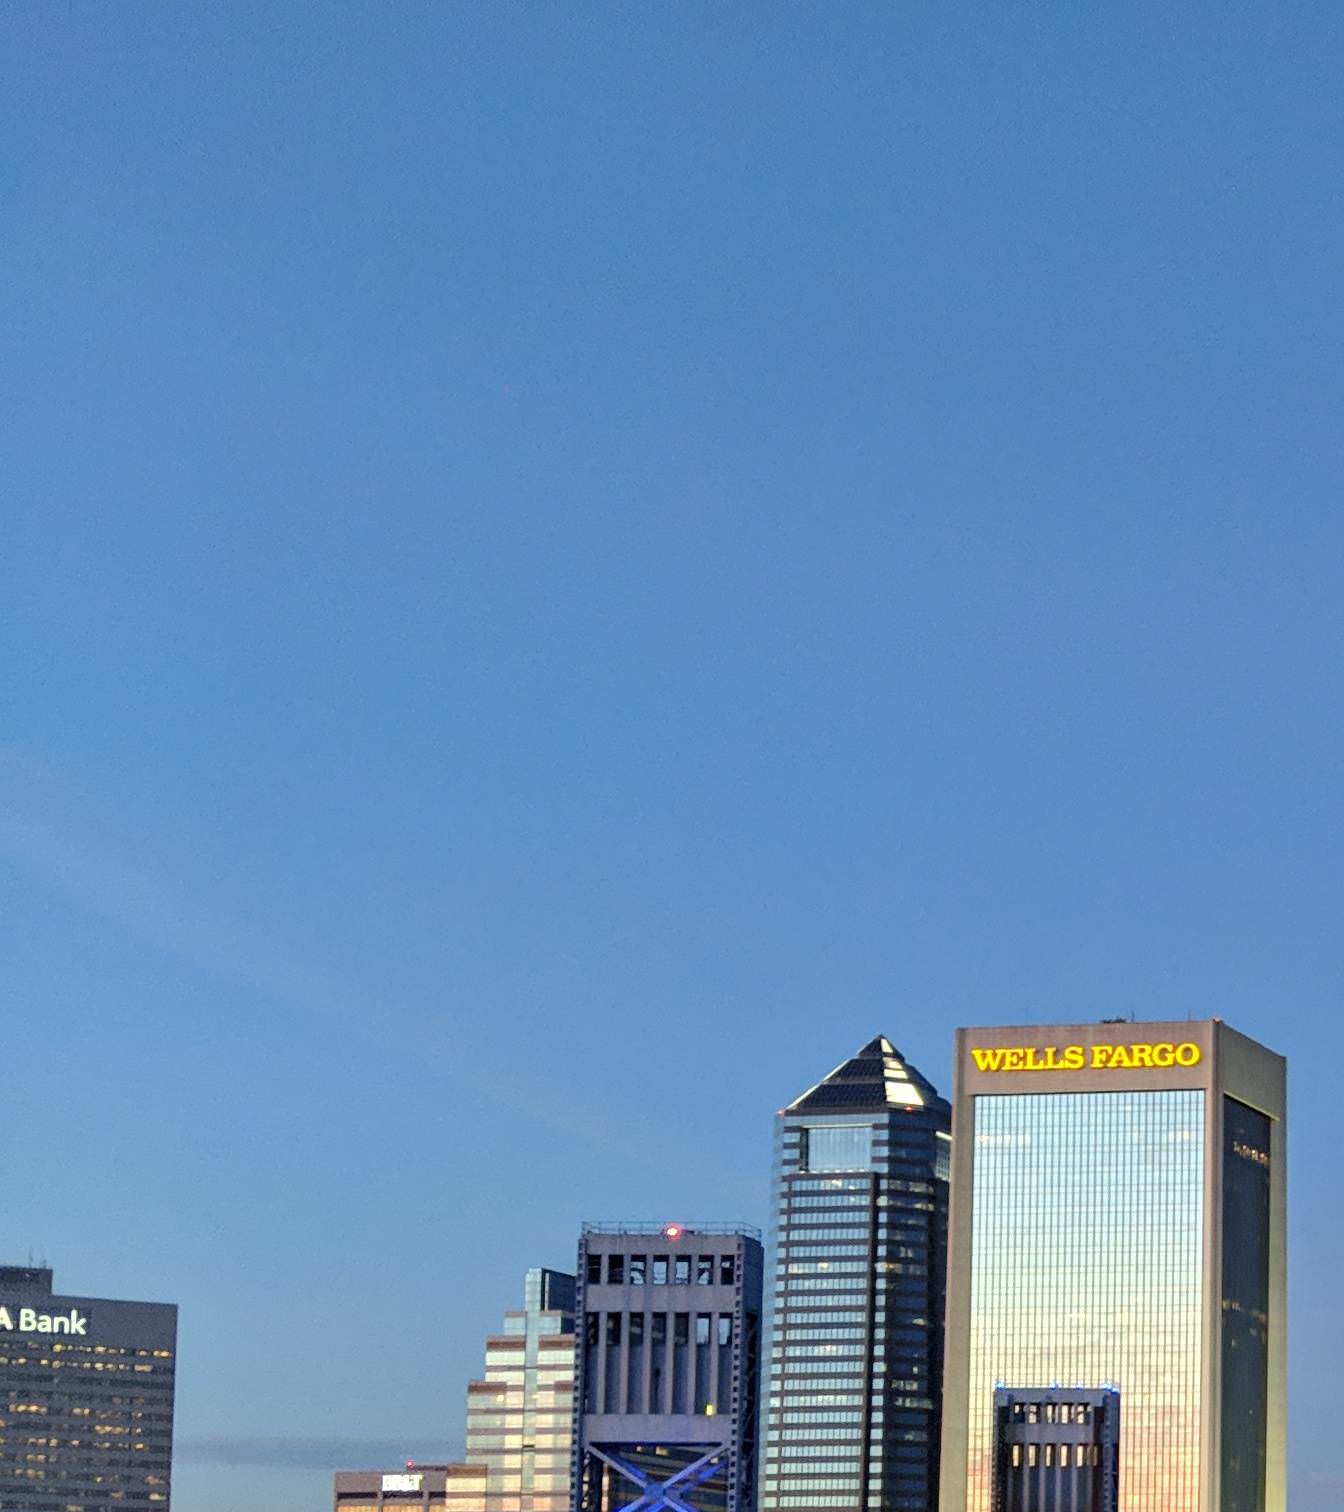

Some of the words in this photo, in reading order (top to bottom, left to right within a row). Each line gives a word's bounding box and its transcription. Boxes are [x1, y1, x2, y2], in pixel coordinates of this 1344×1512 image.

[971, 1046, 1085, 1072] WELLS
[1090, 1042, 1201, 1069] FARGO
[20, 1308, 87, 1335] Bank
